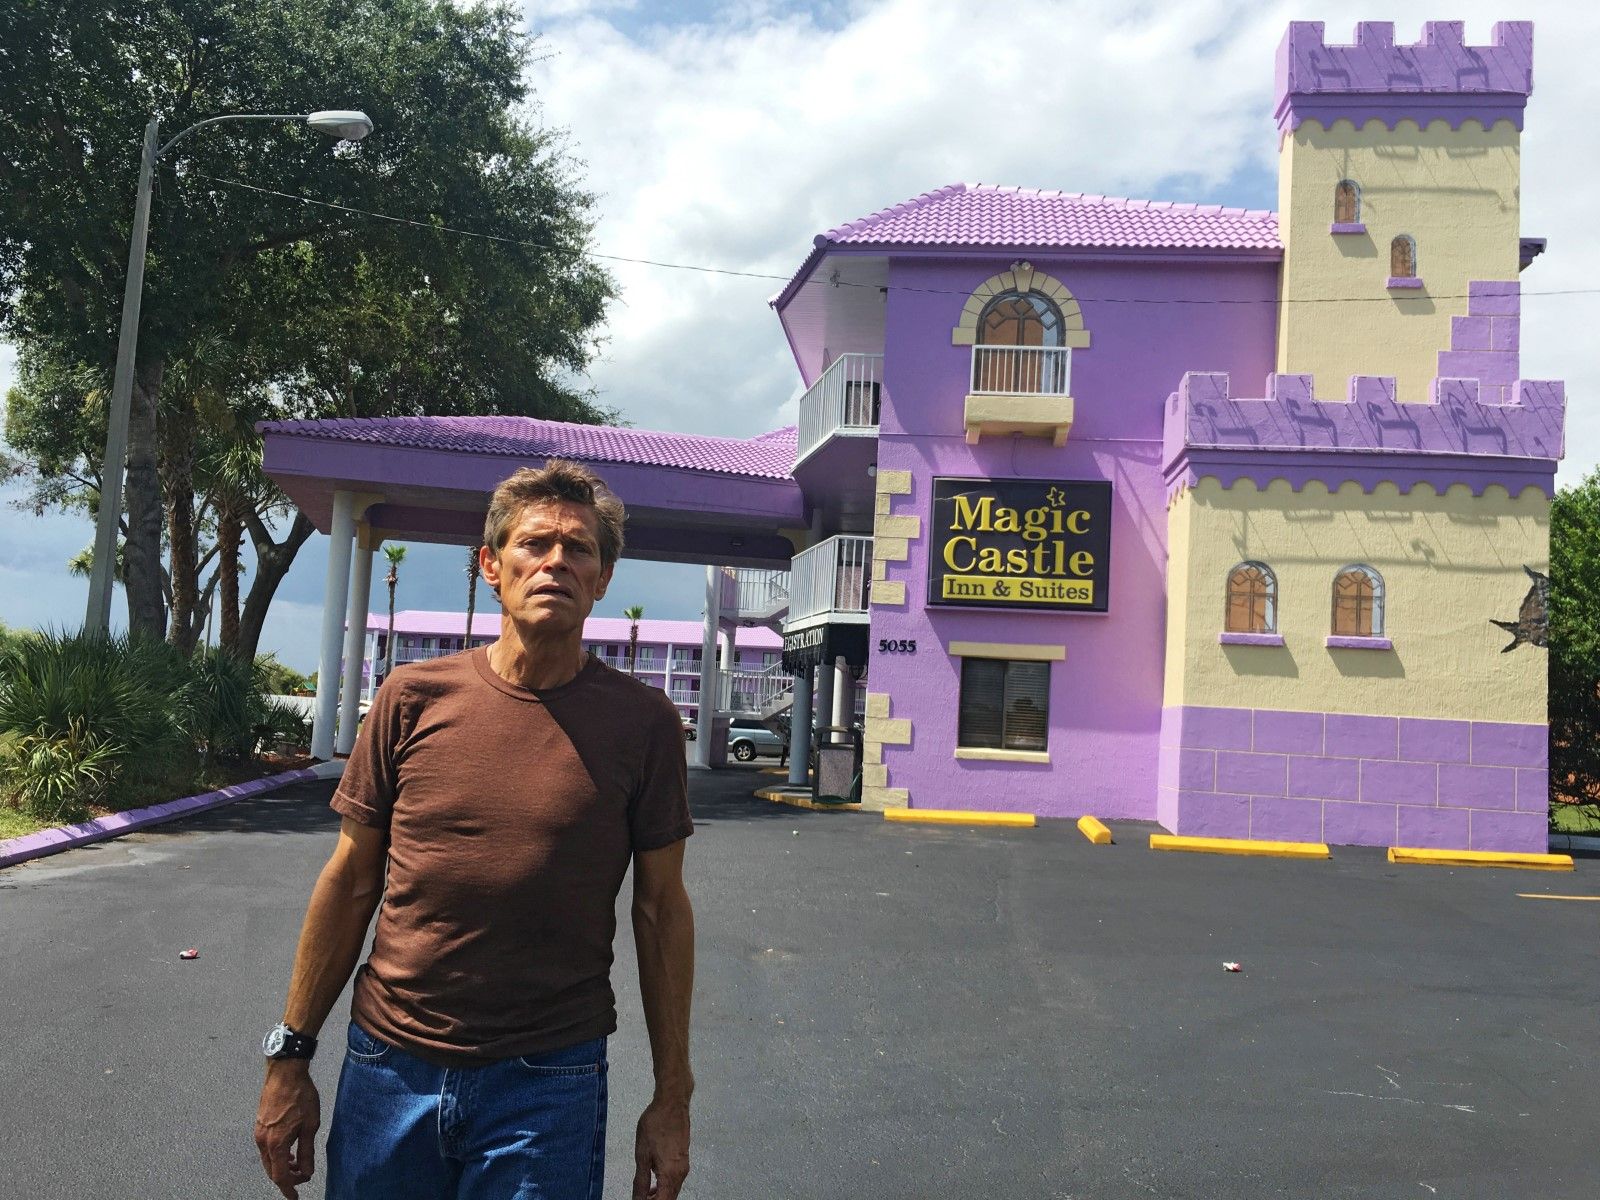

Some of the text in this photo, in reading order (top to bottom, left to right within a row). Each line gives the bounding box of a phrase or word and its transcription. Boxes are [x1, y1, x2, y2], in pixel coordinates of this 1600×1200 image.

[950, 494, 1091, 541] Magic
[943, 536, 1095, 576] Castle
[946, 578, 1089, 600] Inn & Suites
[783, 628, 824, 652] EGISTRATION
[878, 639, 917, 653] 5055
